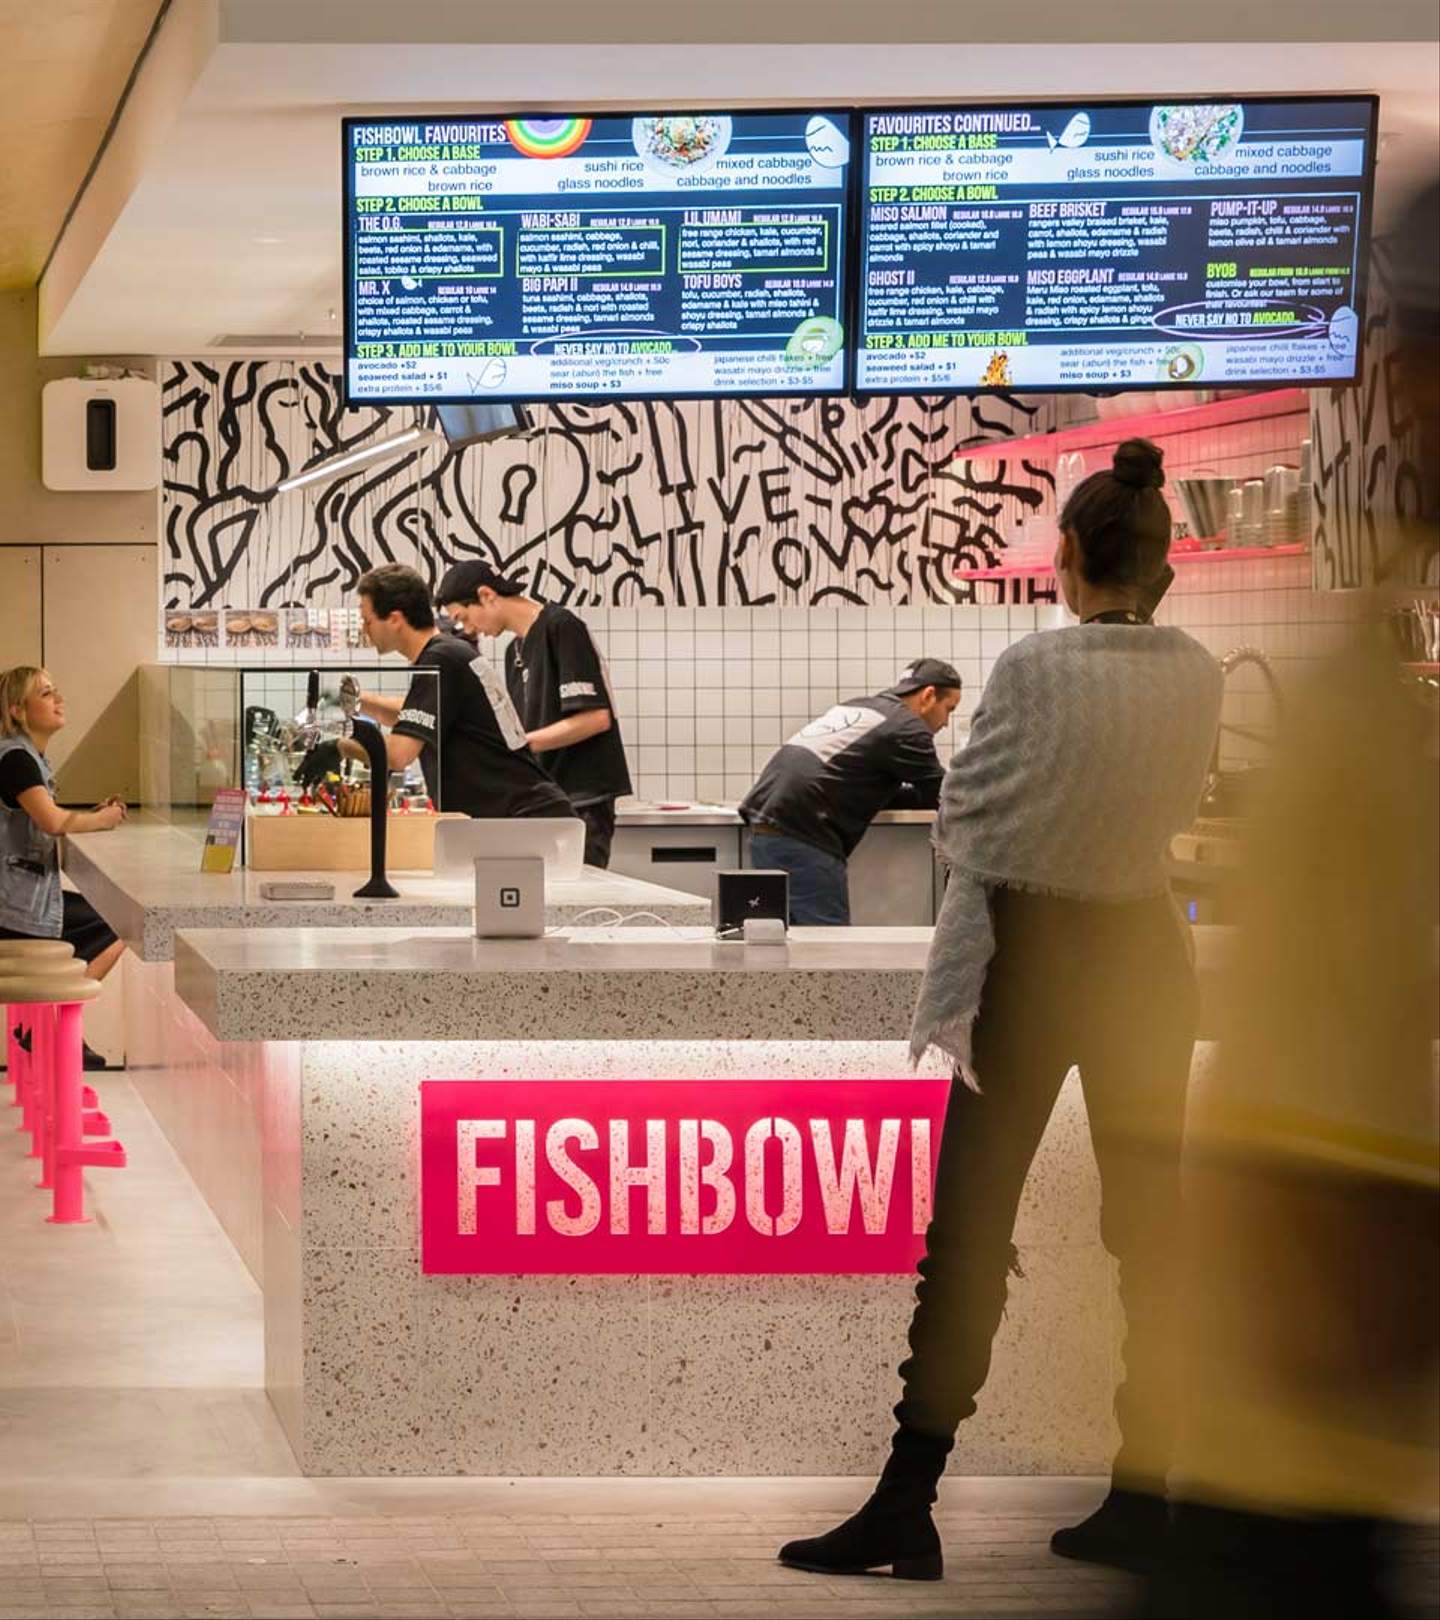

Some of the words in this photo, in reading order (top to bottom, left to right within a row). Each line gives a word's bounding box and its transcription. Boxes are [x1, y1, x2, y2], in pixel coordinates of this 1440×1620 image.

[869, 116, 951, 133] FAVOURITES
[953, 115, 1041, 132] CONTINUED...
[354, 127, 422, 144] FISHBOWL
[424, 125, 506, 142] FAVOURITES
[870, 138, 899, 151] STEP
[902, 137, 911, 151] 1.
[913, 137, 956, 150] CHOOSE
[958, 136, 966, 149] A
[967, 136, 997, 149] BASE
[356, 147, 383, 161] STEP
[386, 147, 395, 160] 1.
[397, 146, 440, 160] CHOOSE
[441, 146, 450, 159] A
[451, 145, 480, 159] BASE
[1094, 150, 1128, 161] sushi
[1131, 149, 1155, 160] rice
[1235, 147, 1273, 158] mixed
[1276, 146, 1332, 159] cabbage
[584, 161, 617, 172] sushi
[621, 160, 644, 171] rice
[716, 158, 754, 169] mixed
[756, 157, 812, 170] cabbage
[875, 155, 914, 166] brown
[918, 155, 941, 165] rice
[944, 154, 954, 165] &
[957, 154, 1013, 167] cabbage
[360, 165, 399, 176] brown
[402, 165, 426, 175] rice
[429, 164, 438, 175] &
[442, 163, 497, 177] cabbage
[942, 170, 981, 181] brown
[984, 169, 1009, 180] rice
[1067, 167, 1100, 180] glass
[1103, 166, 1154, 177] noodles
[1194, 164, 1249, 177] cabbage
[1252, 163, 1277, 174] and
[1280, 162, 1332, 173] noodles
[428, 180, 466, 191] brown
[469, 179, 493, 190] rice
[558, 178, 591, 191] glass
[594, 177, 644, 188] noodles
[676, 175, 731, 189] cabbage
[734, 174, 758, 185] and
[761, 174, 812, 184] noodles
[870, 188, 897, 202] STEP
[899, 188, 910, 202] 2.
[911, 187, 954, 201] CHOOSE
[956, 186, 964, 200] A
[966, 186, 998, 200] BOWL
[356, 198, 384, 212] STEP
[385, 198, 396, 212] 2.
[397, 197, 440, 211] CHOOSE
[442, 197, 450, 211] A
[451, 196, 484, 210] BOWL
[1029, 204, 1057, 218] BEEF
[1059, 203, 1107, 217] BRISKET
[1211, 201, 1277, 215] PUMP-IT-UP
[521, 214, 581, 227] WABI-SABI
[870, 207, 898, 221] MISO
[900, 206, 947, 220] SALMON
[358, 217, 380, 231] THE
[381, 216, 403, 230] O.G.
[869, 271, 904, 285] GHOST
[906, 271, 915, 285] II
[1027, 271, 1055, 285] MISO
[1057, 270, 1114, 284] EGGPLANT
[1206, 264, 1238, 278] BYOB
[358, 281, 379, 295] MR.
[381, 281, 390, 295] X
[522, 278, 541, 292] BIG
[542, 278, 568, 292] PAPI
[569, 277, 578, 291] II
[683, 275, 711, 288] TOFU
[712, 274, 742, 288] BOYS
[1175, 314, 1205, 326] NEVER
[1206, 313, 1224, 326] SAY
[1224, 313, 1238, 325] NO
[1239, 313, 1251, 325] TO
[1252, 312, 1301, 324] AVOCADO...
[866, 335, 893, 348] STEP
[894, 334, 905, 348] 3.
[907, 334, 930, 347] ADD
[932, 333, 949, 347] ME
[950, 333, 965, 347] TO
[966, 333, 995, 346] YOUR
[997, 332, 1028, 345] BOWL
[357, 344, 384, 357] STEP
[385, 344, 396, 357] 3.
[398, 343, 421, 357] ADD
[422, 343, 439, 356] ME
[441, 342, 455, 356] TO
[456, 342, 485, 355] YOUR
[486, 341, 518, 355] BOWL
[554, 343, 583, 356] NEVER
[584, 343, 601, 355] SAY
[603, 342, 616, 355] NO
[617, 342, 629, 354] TO
[630, 341, 679, 354] AVOCADO...
[623, 466, 799, 549] LIVE
